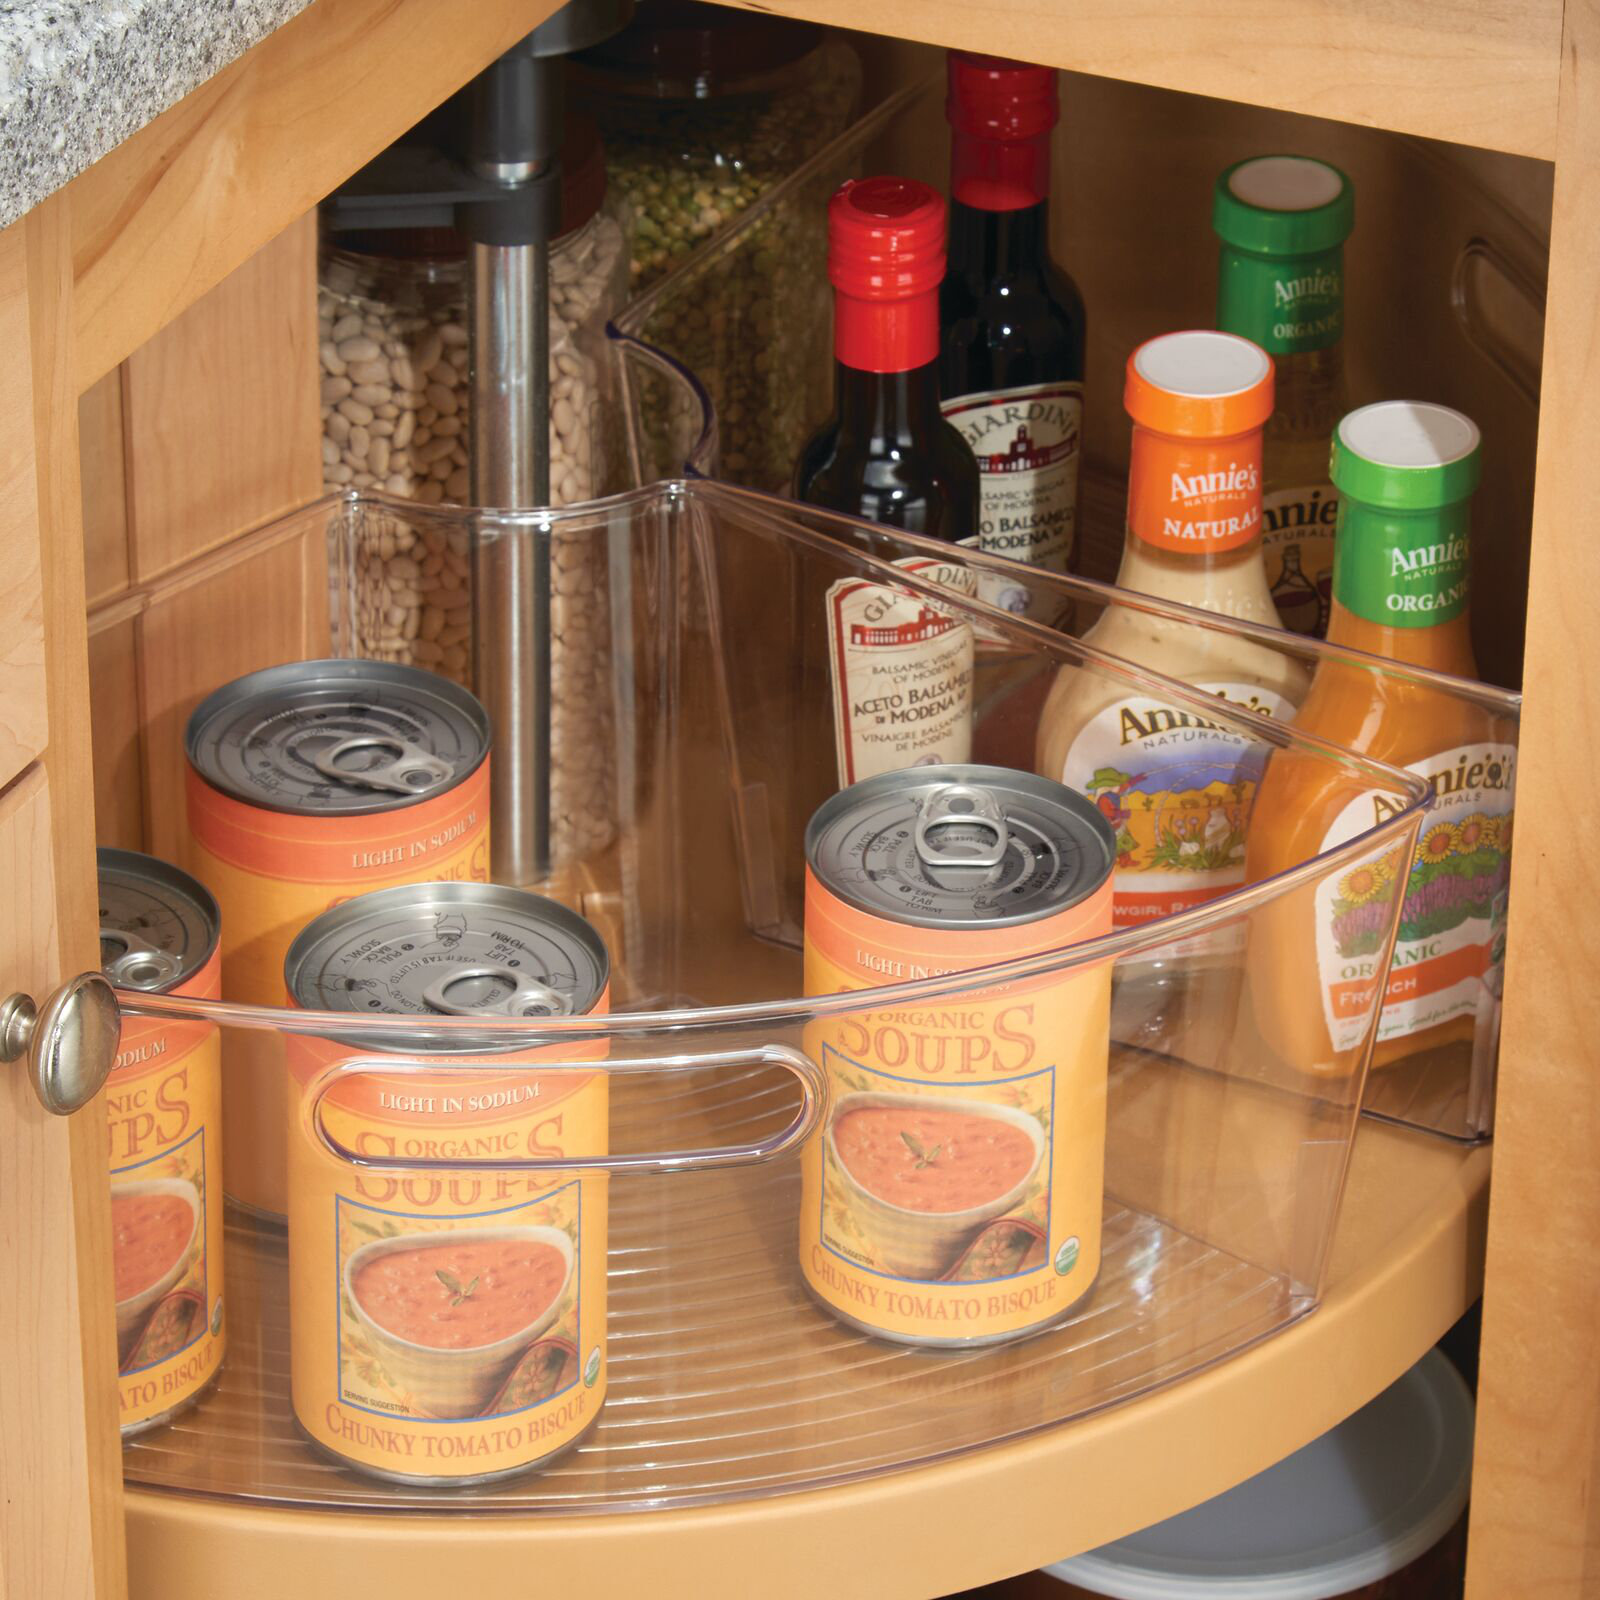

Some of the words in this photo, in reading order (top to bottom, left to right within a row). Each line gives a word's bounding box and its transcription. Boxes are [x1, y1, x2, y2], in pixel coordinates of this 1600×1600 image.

[1170, 463, 1258, 502] Annie's
[1390, 533, 1469, 577] Annie's
[854, 694, 904, 717] ACETO
[891, 697, 955, 724] MODENA
[1143, 731, 1242, 750] NATURALS
[352, 847, 405, 869] LIGHT
[410, 840, 428, 858] IN
[430, 811, 478, 853] SODIUM
[340, 938, 381, 965] SLOWLY
[366, 945, 392, 962] BACK
[376, 950, 403, 965] PULL
[423, 954, 444, 965] TAB
[857, 950, 906, 978] LIGHT
[390, 963, 413, 984] LIFTED
[877, 1011, 985, 1030] ORGANIC
[111, 1037, 168, 1071] ODIUM
[380, 1092, 435, 1113] LIGHT
[442, 1097, 464, 1113] IN
[468, 1082, 541, 1111] SODIUM
[404, 1131, 520, 1159] ORGANIC
[811, 1244, 880, 1309] CHUNKY
[884, 1290, 982, 1321] TOMATO
[988, 1277, 1057, 1316] BISQUE
[325, 1403, 417, 1457] CHUNKY
[422, 1426, 524, 1459] TOMATO
[528, 1391, 588, 1444] BISQUE
